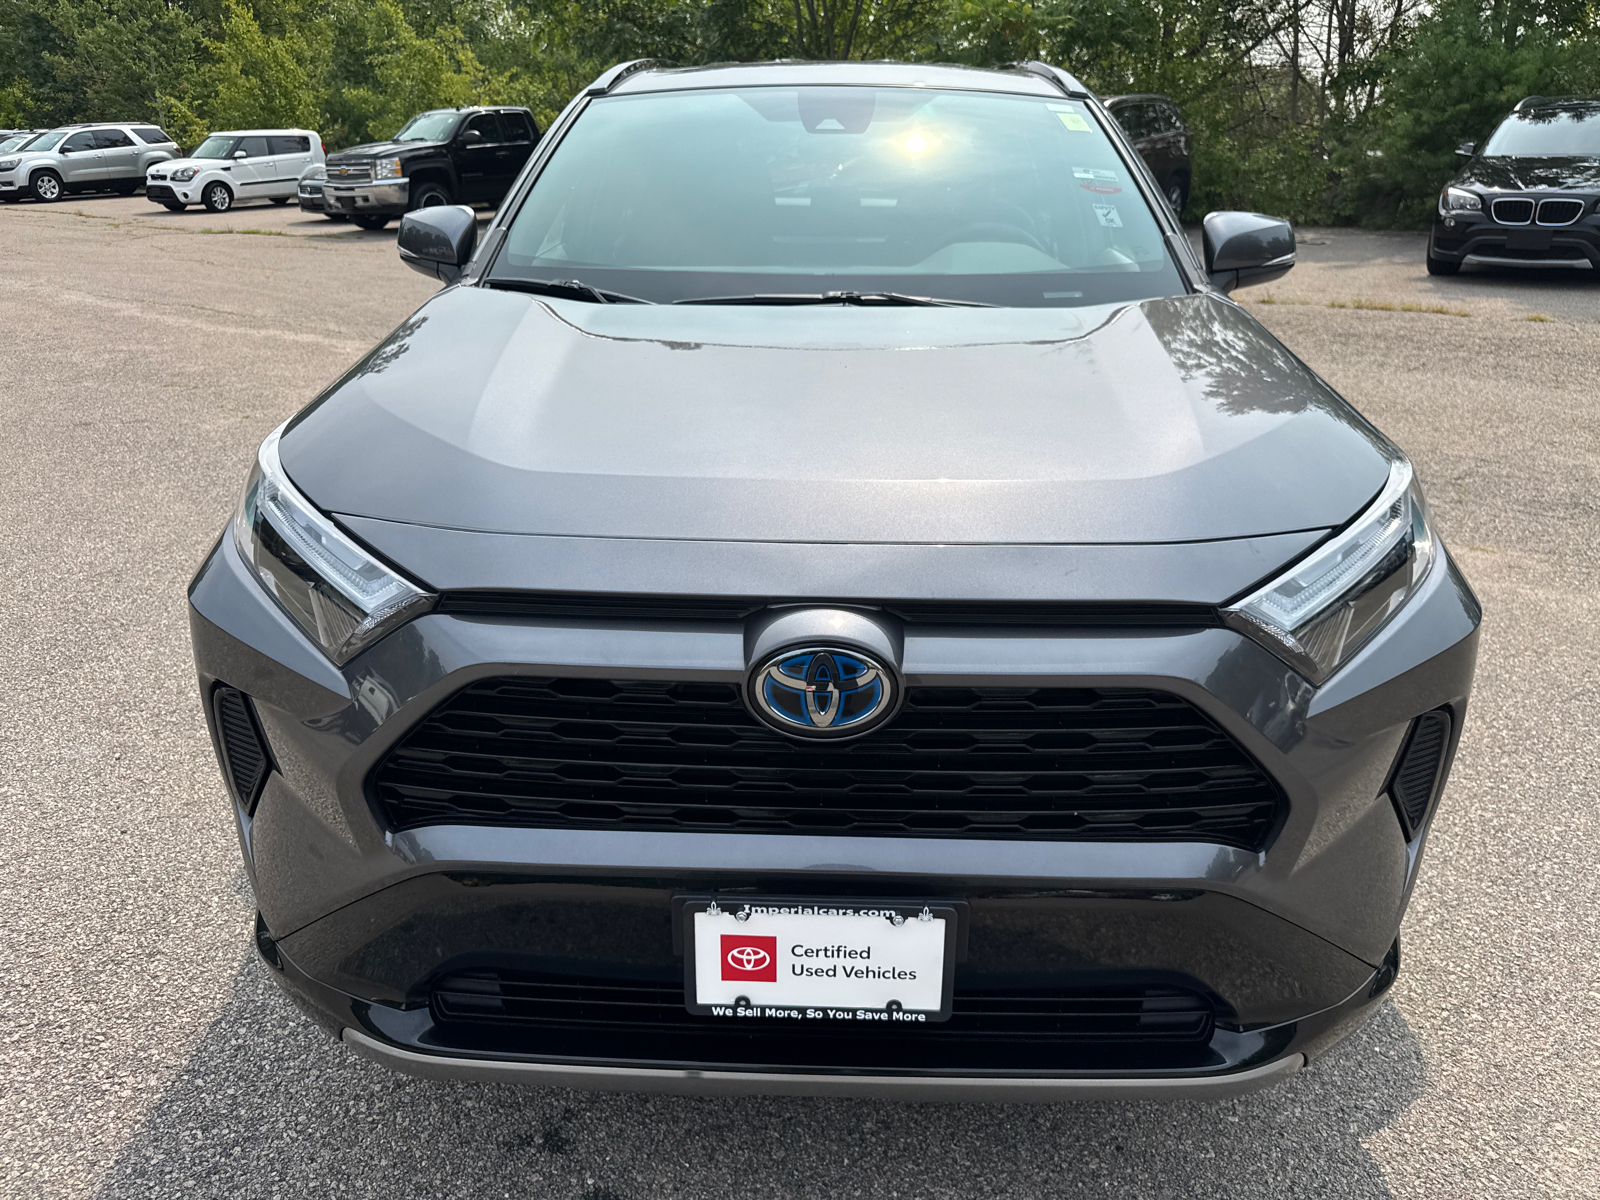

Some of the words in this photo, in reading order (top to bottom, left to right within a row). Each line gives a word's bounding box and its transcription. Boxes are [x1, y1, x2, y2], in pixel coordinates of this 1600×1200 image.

[743, 904, 896, 918] Imperialcars.com
[791, 944, 871, 960] Certified
[791, 963, 837, 978] Used
[843, 965, 917, 980] Vehicles
[712, 1006, 733, 1017] We
[736, 1006, 761, 1017] Sell
[765, 1008, 803, 1019] More,
[806, 1009, 823, 1019] So
[827, 1009, 853, 1020] You
[856, 1010, 889, 1021] Save
[892, 1011, 926, 1022] More
